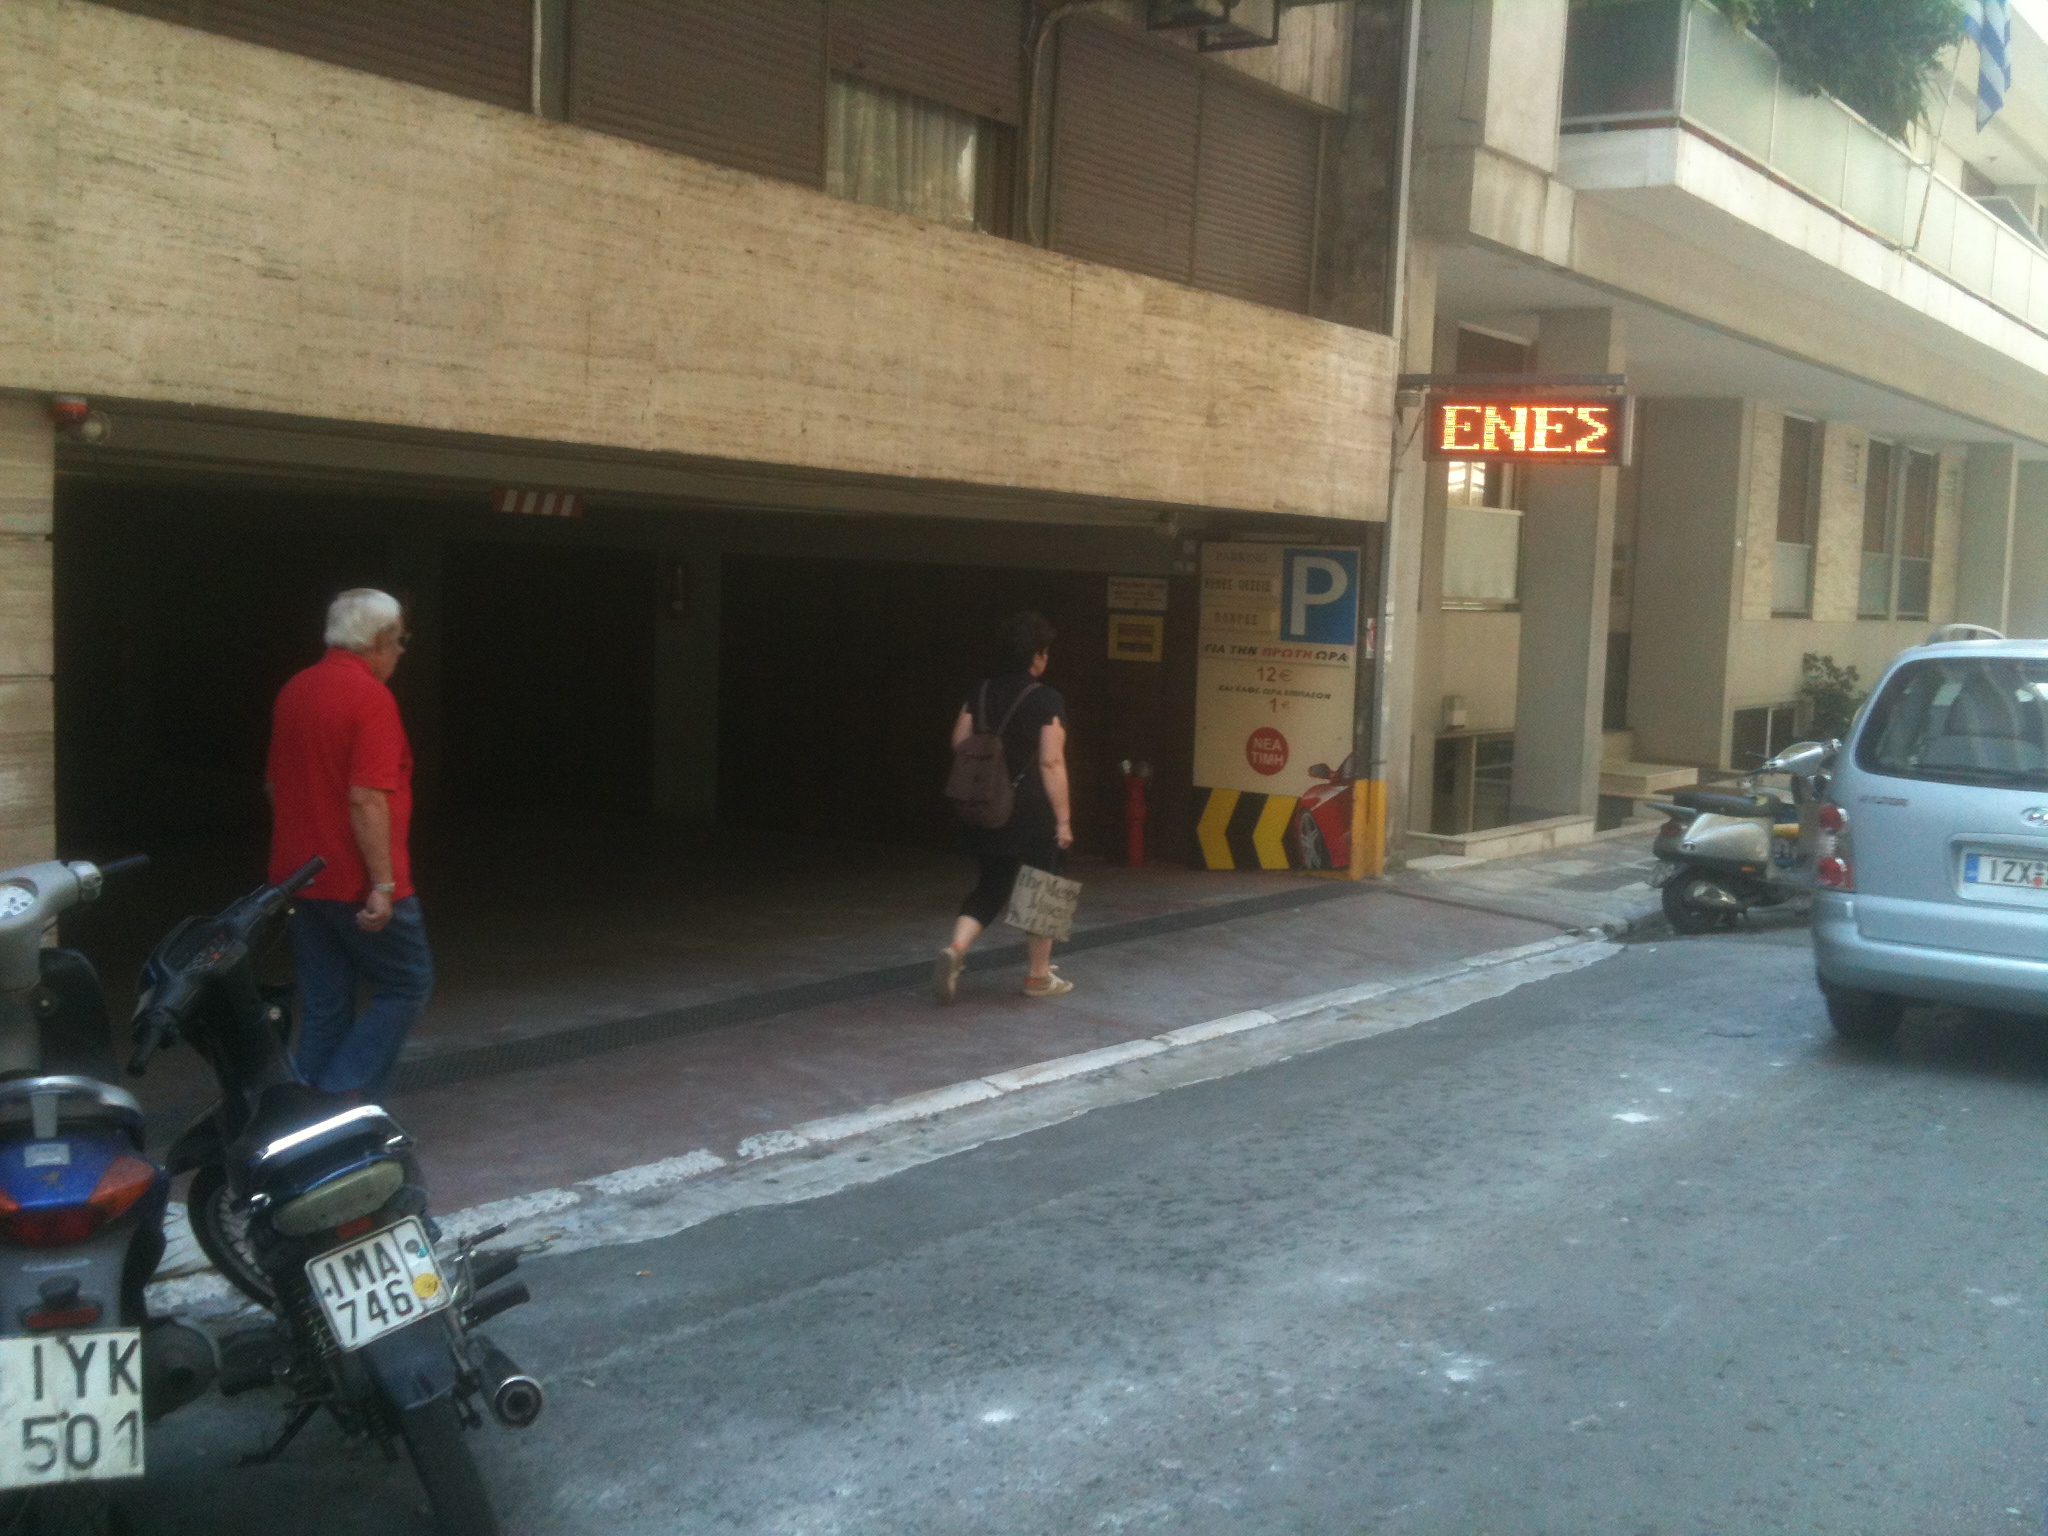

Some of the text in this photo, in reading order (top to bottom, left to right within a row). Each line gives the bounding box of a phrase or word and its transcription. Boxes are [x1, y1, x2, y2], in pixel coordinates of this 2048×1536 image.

[1204, 643, 1348, 662] ΓΙΑ ΤΗΝ ΠΡΩΤΗ ΩΡΑ
[1253, 737, 1283, 752] ΝΕΑ
[1251, 751, 1285, 767] ΤΙΜΗ
[336, 1279, 415, 1340] 746
[22, 1409, 140, 1475] 501
